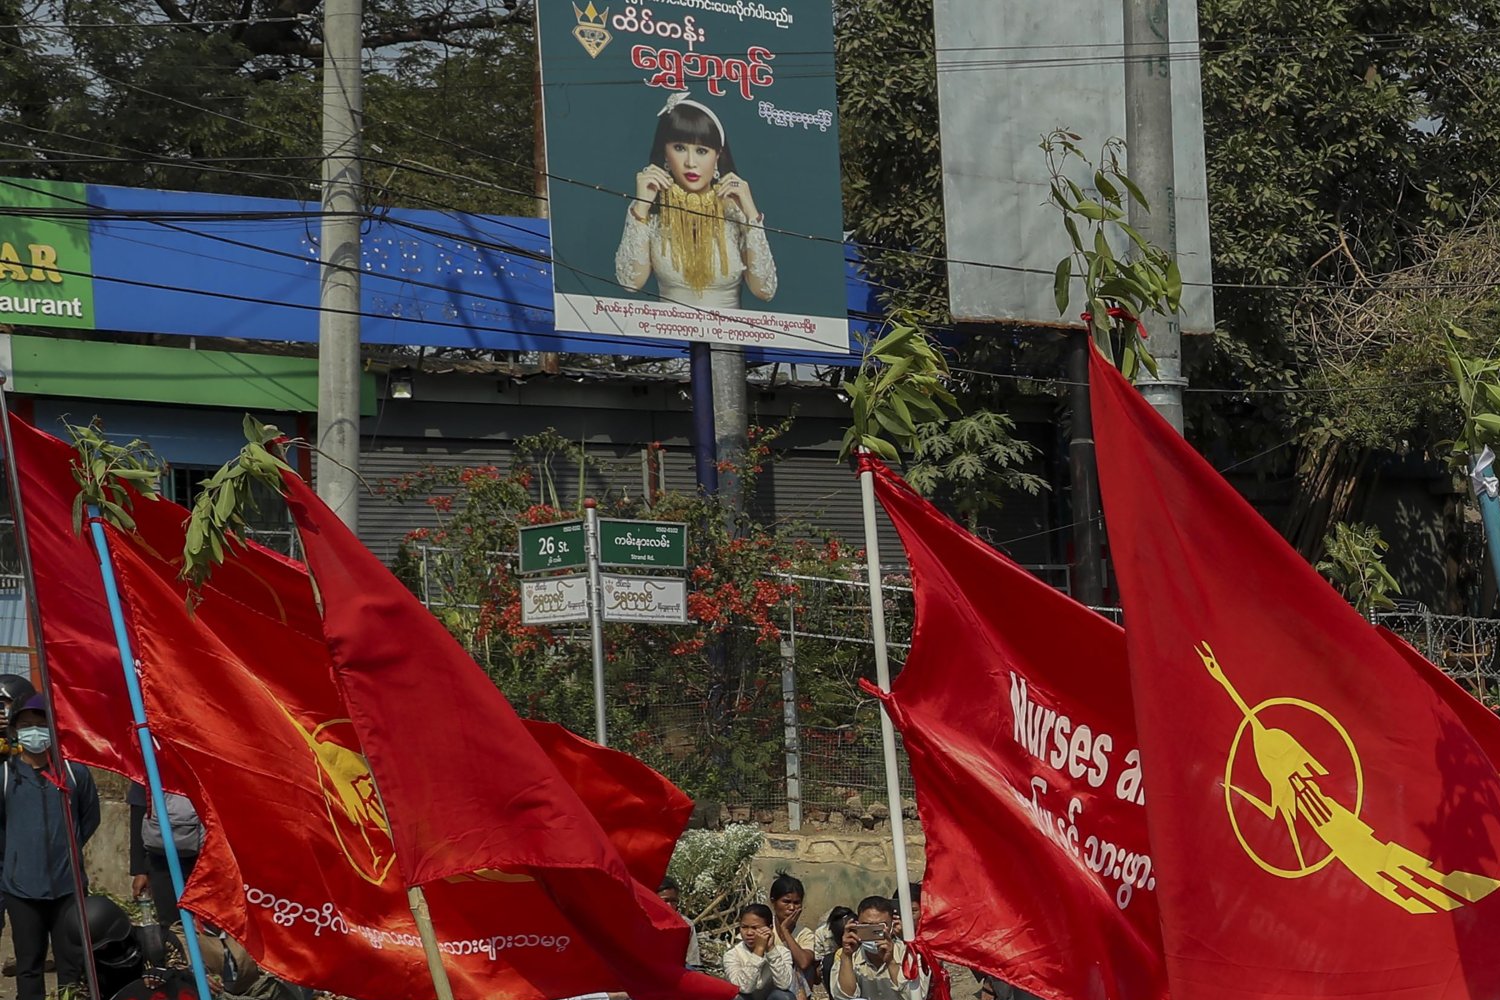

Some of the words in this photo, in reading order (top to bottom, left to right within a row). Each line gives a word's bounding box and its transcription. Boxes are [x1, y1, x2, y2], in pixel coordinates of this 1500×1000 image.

[612, 7, 705, 50] ထိပ်တန်း
[631, 44, 775, 100] ရွှေဘုရင်
[0, 296, 82, 317] aurant
[538, 537, 555, 555] 26
[558, 541, 570, 553] St.
[614, 532, 670, 550] ကမ်းနားလမ်း
[1010, 671, 1113, 787] Nurses
